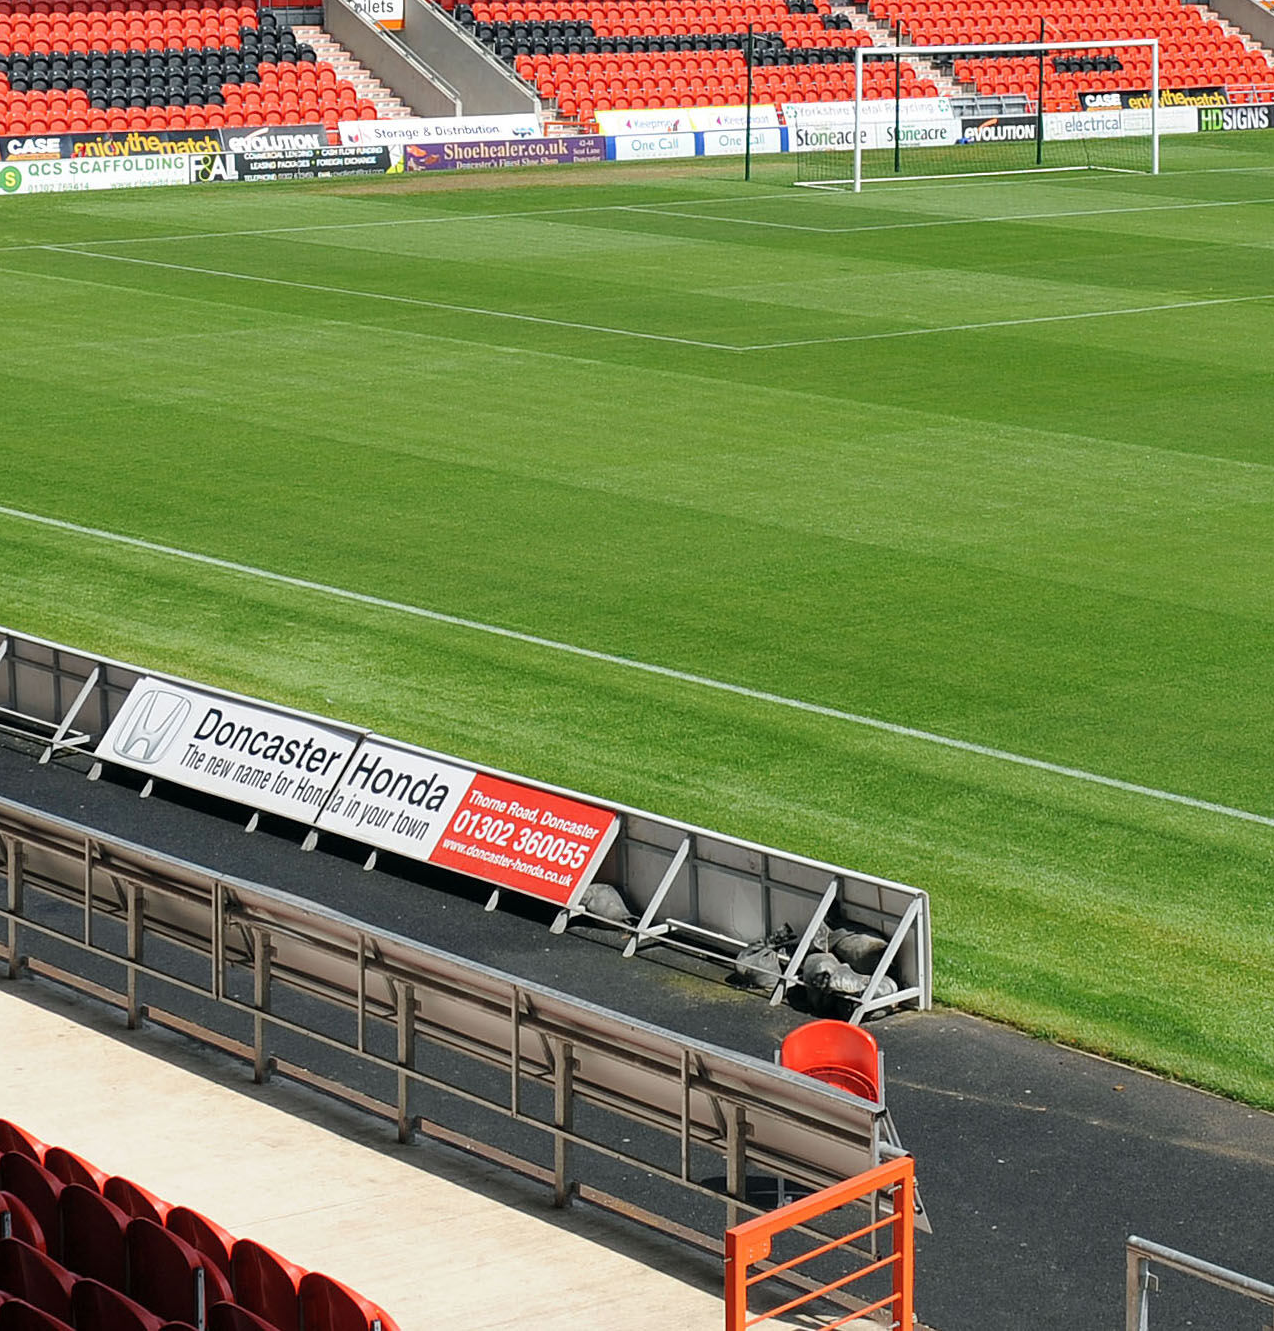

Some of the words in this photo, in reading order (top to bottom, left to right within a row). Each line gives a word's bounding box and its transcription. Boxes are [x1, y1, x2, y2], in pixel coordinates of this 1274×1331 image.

[1085, 93, 1122, 107] CASE
[1164, 89, 1186, 107] the
[1185, 92, 1227, 107] match
[1064, 114, 1122, 133] electrical
[1201, 106, 1269, 130] HDSIGNS
[374, 126, 419, 141] Storage
[423, 125, 433, 137] &
[435, 122, 500, 137] Distribution
[719, 134, 742, 147] One
[7, 138, 61, 155] CASE
[127, 132, 160, 153] the
[158, 135, 221, 156] match
[444, 139, 568, 160] Shoehealer.co.uk
[631, 138, 654, 152] One
[658, 137, 679, 151] Call
[28, 163, 62, 177] QCS
[70, 157, 185, 175] SCAFFOLDING
[193, 706, 342, 777] Doncaster
[347, 751, 450, 814] Honda
[180, 743, 203, 771] The
[204, 755, 231, 782] new
[232, 763, 269, 791] name
[271, 767, 290, 796] for
[344, 792, 358, 820] in
[360, 801, 394, 836] your
[395, 809, 430, 841] town
[468, 788, 509, 815] Thorne
[507, 800, 539, 826] Road,
[538, 809, 600, 841] Doncaster
[452, 808, 510, 848] 01302
[511, 827, 591, 870] 360055
[442, 837, 574, 889] www.doncaster-honda.co.uk
